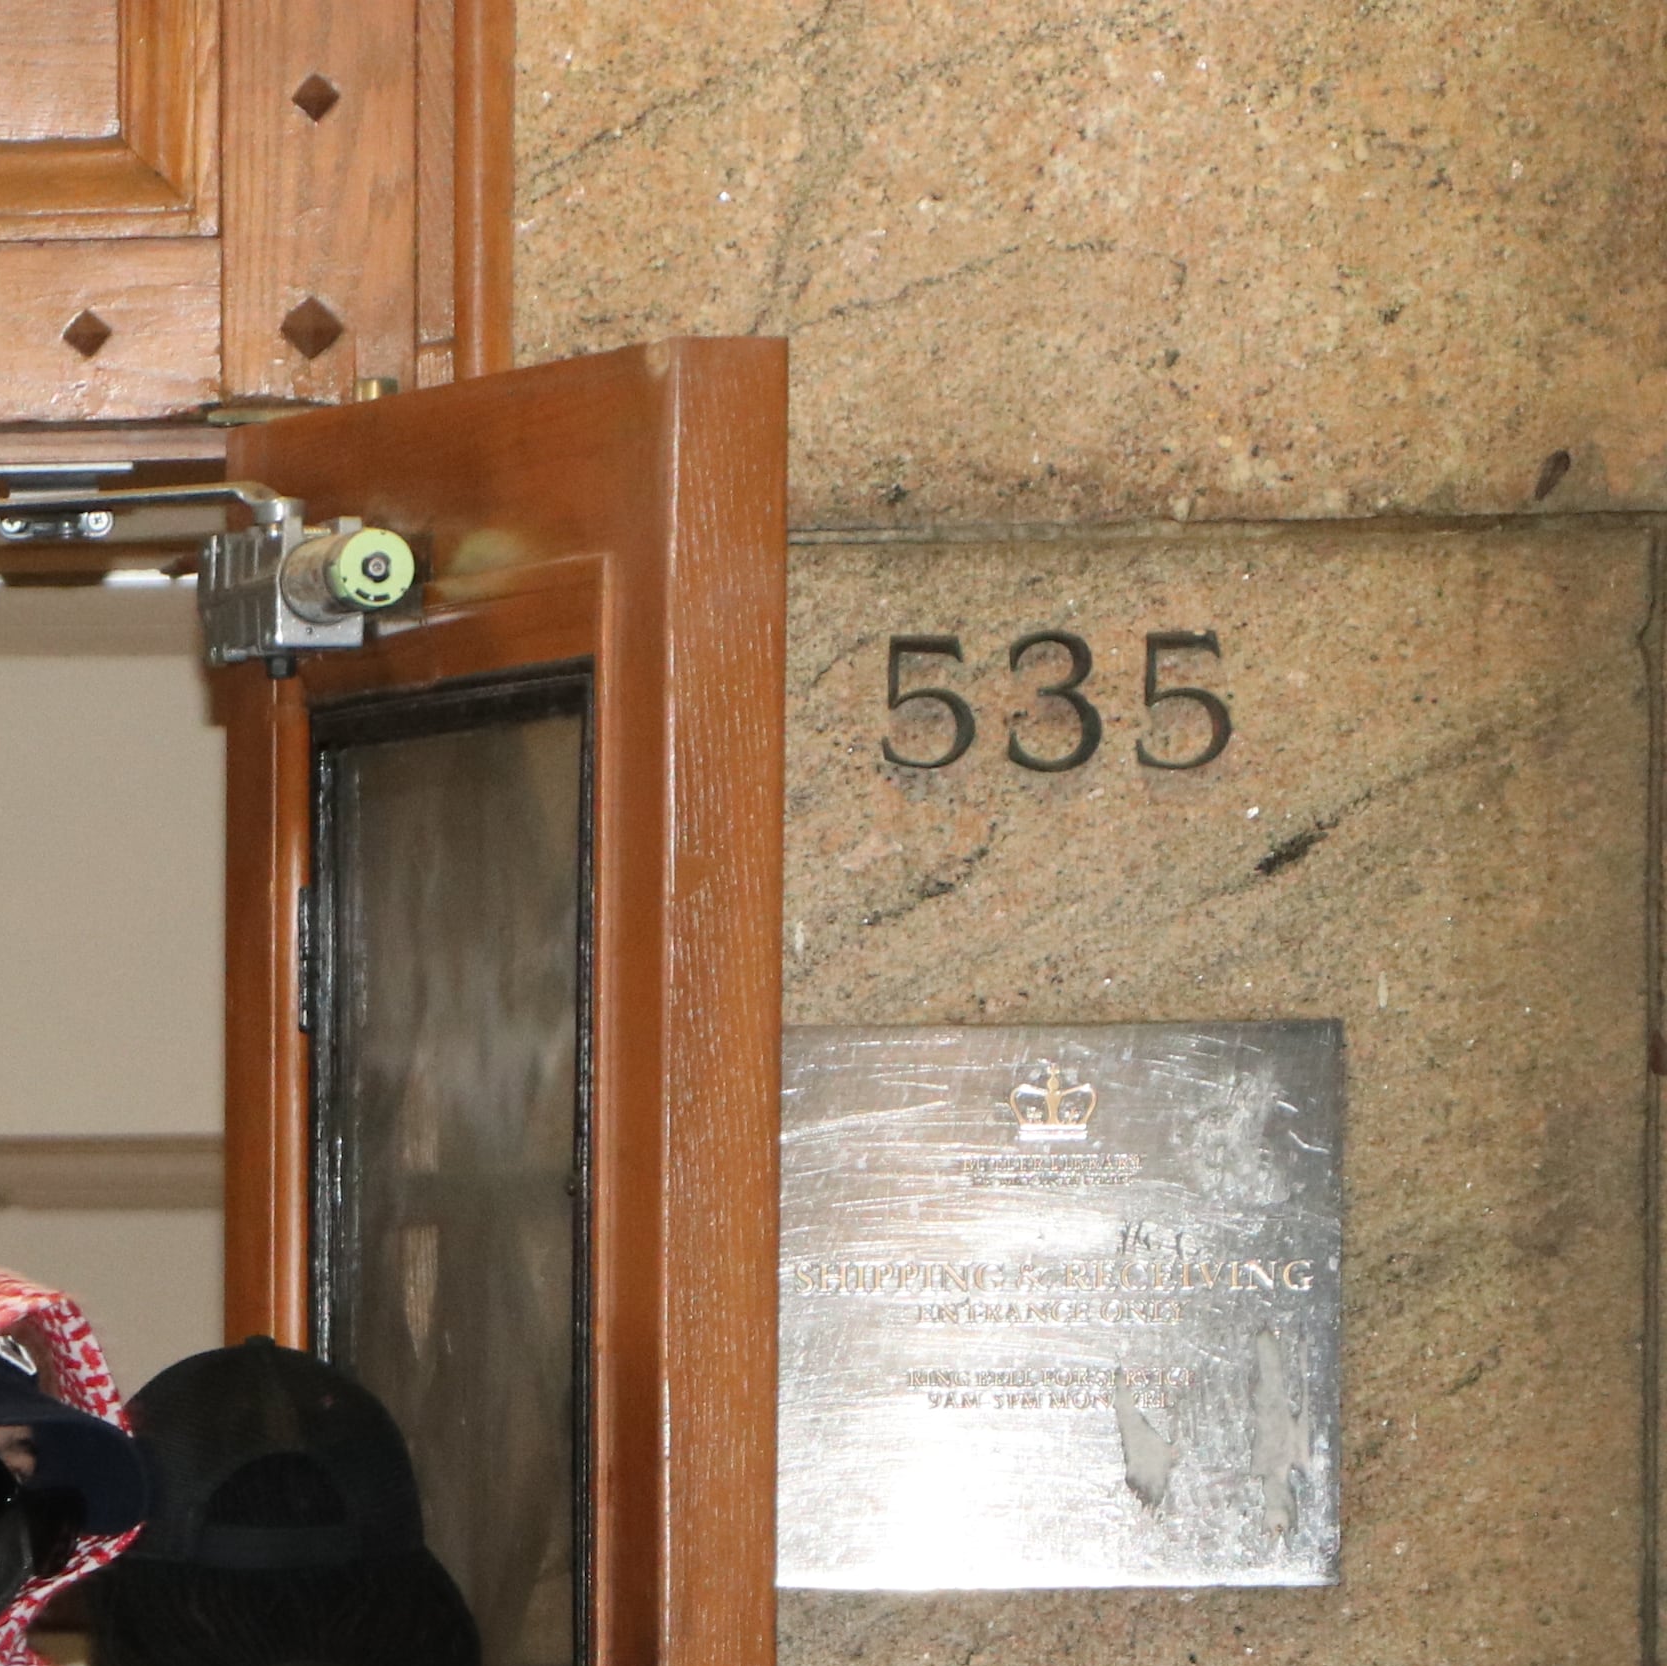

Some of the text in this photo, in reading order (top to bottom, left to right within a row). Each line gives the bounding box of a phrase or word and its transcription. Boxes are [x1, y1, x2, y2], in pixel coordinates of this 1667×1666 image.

[881, 628, 1232, 773] 535
[794, 1259, 1315, 1296] SHIPPING & RECEIVING
[916, 1299, 1187, 1326] ENTRANCE ONLY
[907, 1367, 970, 1387] RING
[1040, 1366, 1089, 1387] FOR
